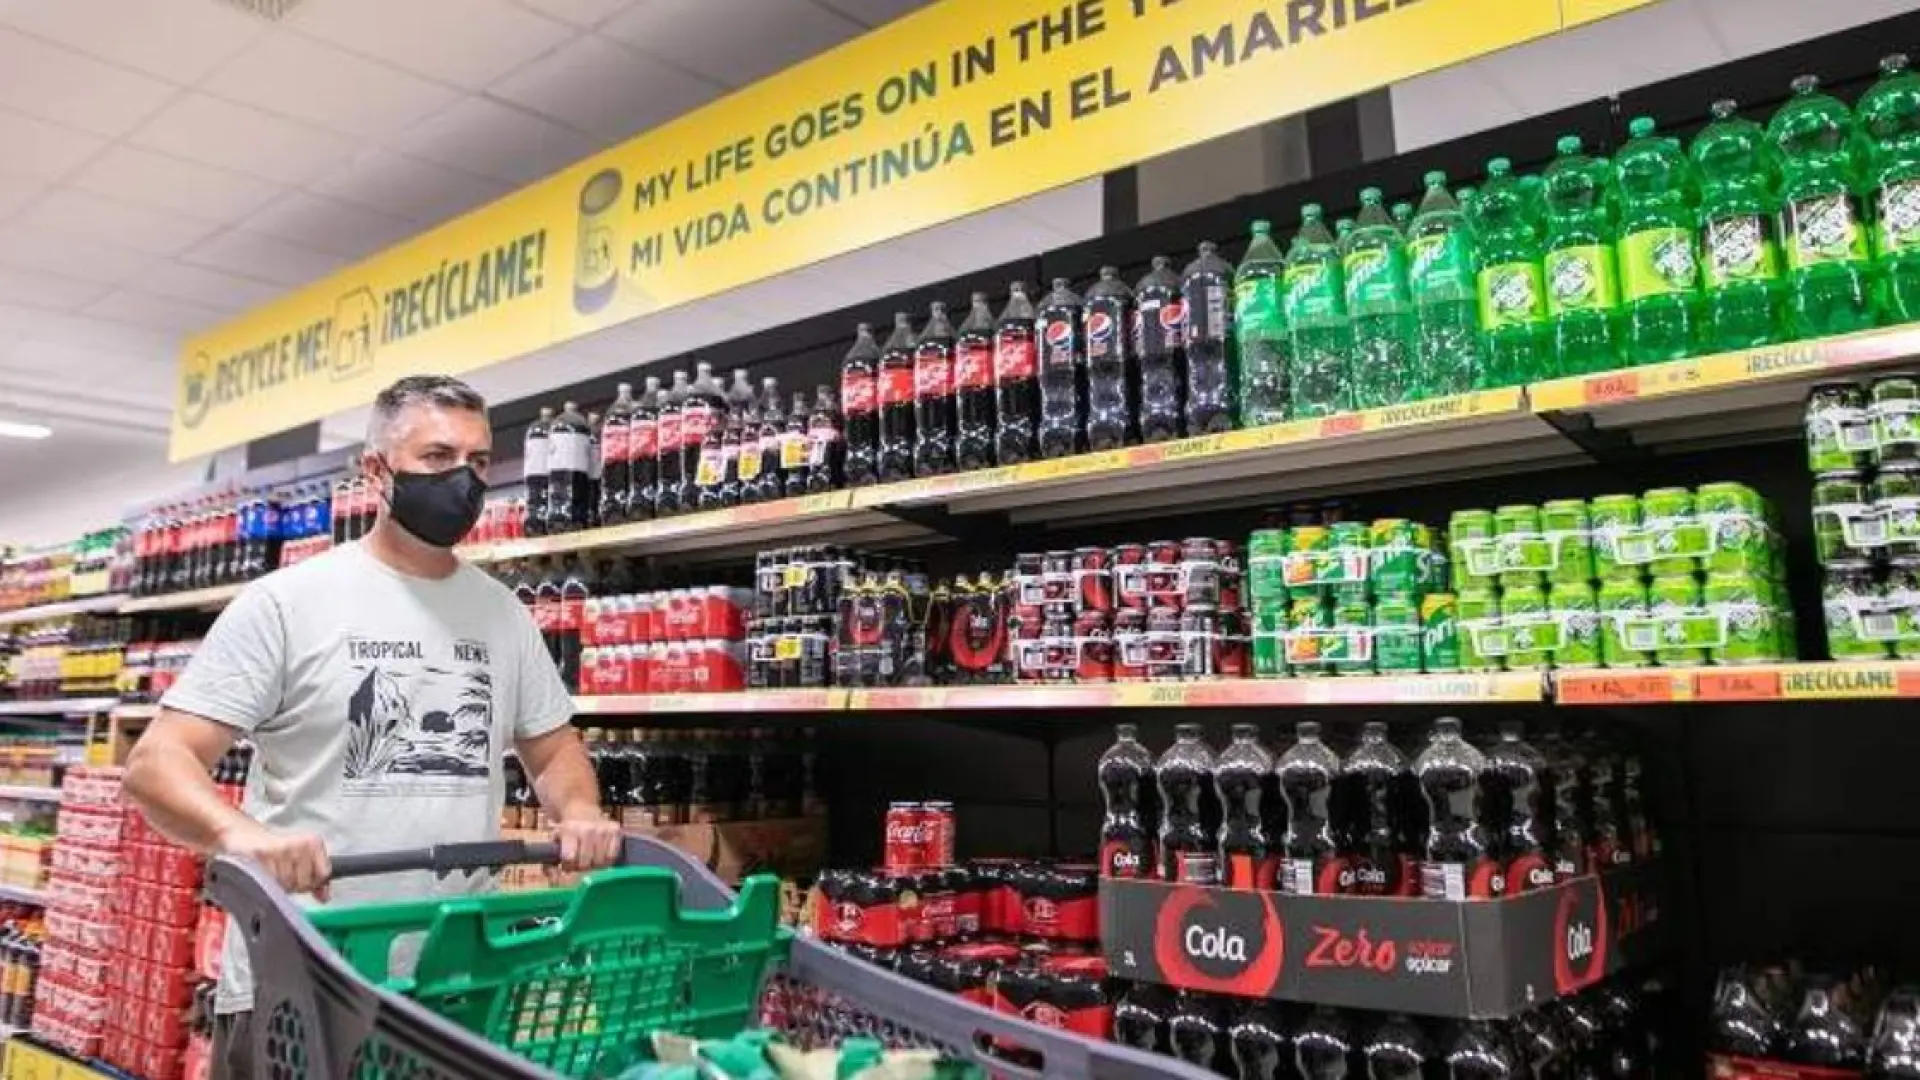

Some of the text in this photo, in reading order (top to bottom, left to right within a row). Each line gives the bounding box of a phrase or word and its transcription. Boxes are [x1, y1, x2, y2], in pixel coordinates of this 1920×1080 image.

[634, 0, 1107, 213] MY LIFE GOES ON IN THE
[631, 232, 663, 273] MI
[673, 203, 752, 257] VIDA
[762, 119, 976, 224] CONTINÚA
[990, 89, 1053, 148] EN
[1070, 66, 1132, 121] EL
[381, 227, 547, 345] ¡RECÍCLAME!
[216, 334, 292, 402] RECYCLE
[349, 640, 424, 661] TROPICAL
[1113, 850, 1140, 867] Cola
[1356, 867, 1386, 883] Cola
[1185, 924, 1397, 972] Cola Zero
[1568, 922, 1593, 961] Cola
